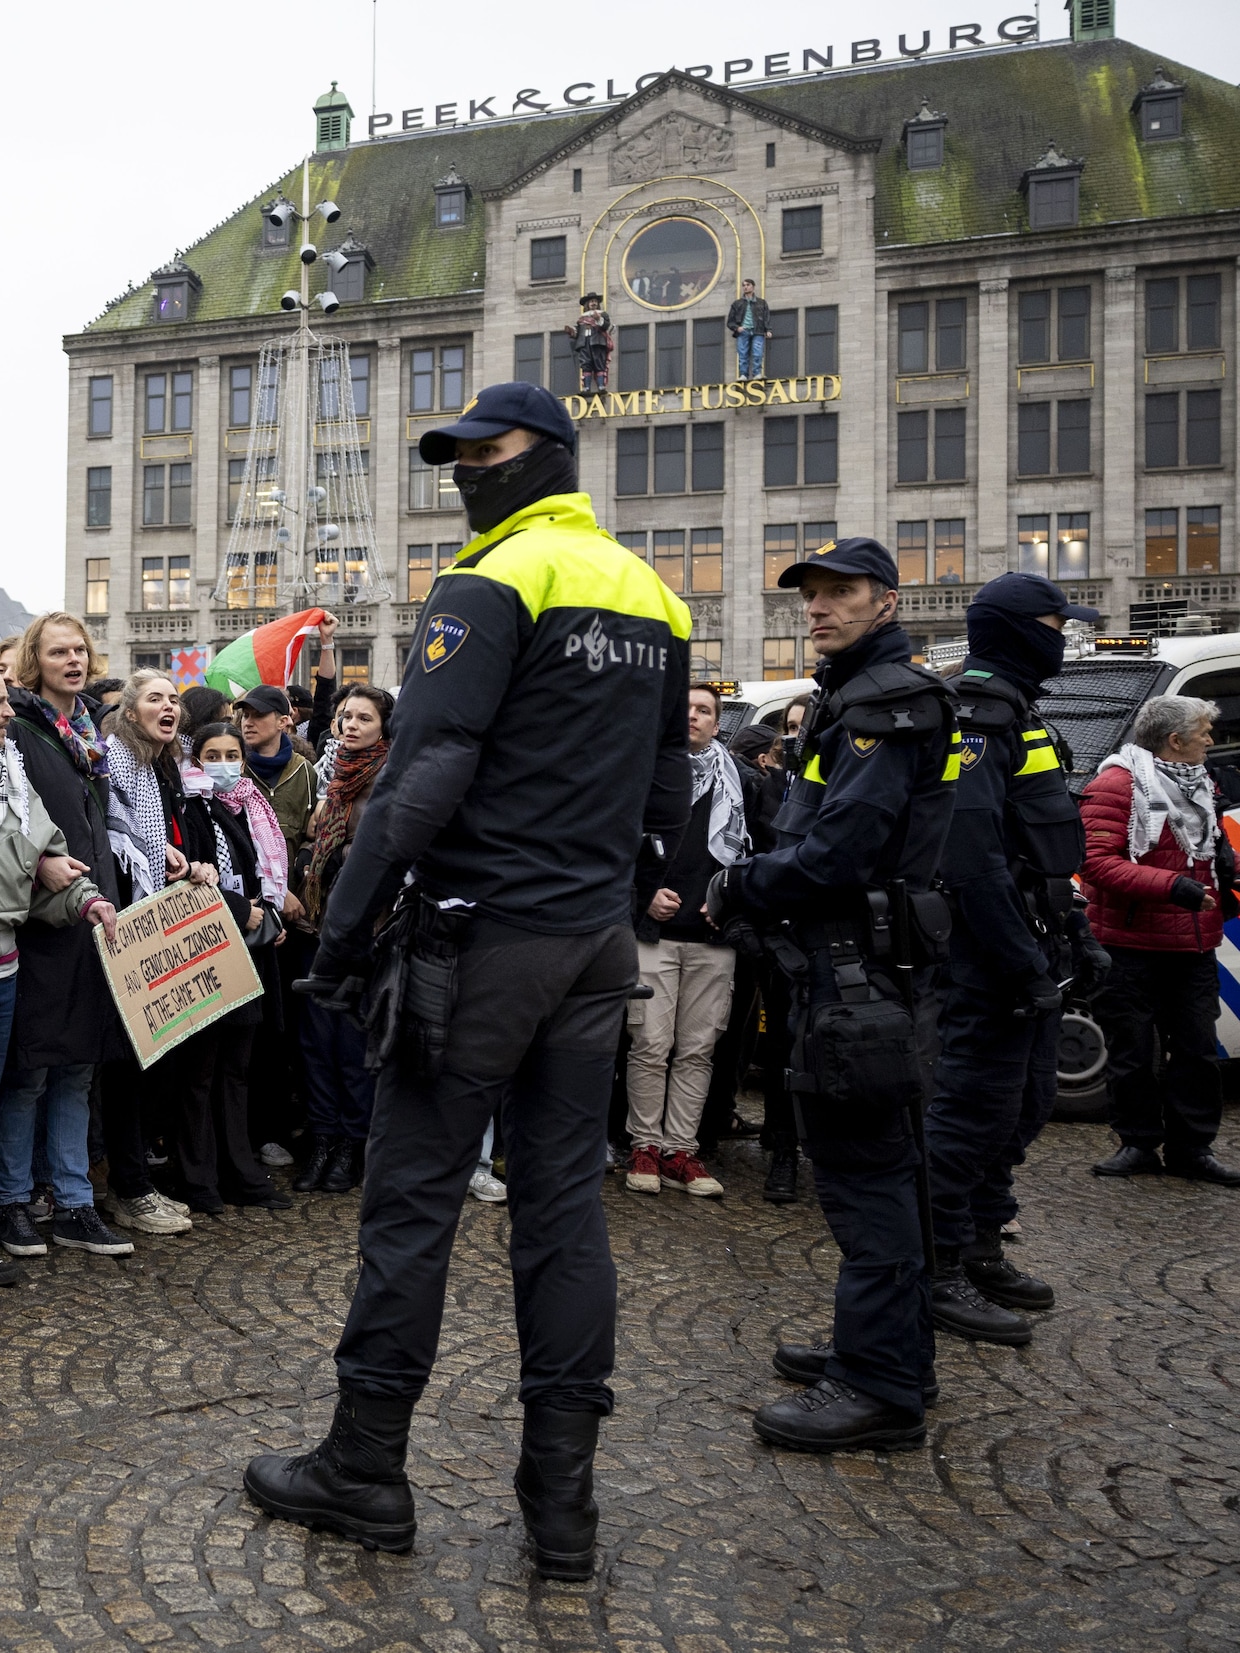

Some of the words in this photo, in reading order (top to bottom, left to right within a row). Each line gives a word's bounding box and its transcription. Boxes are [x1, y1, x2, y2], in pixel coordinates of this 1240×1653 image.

[368, 95, 497, 136] PEEK
[559, 388, 666, 420] DAME
[675, 375, 842, 413] TUSSAUD
[430, 621, 465, 636] POLITIE
[564, 630, 668, 673] POLITIE
[118, 922, 137, 948] CAN
[133, 909, 159, 942] FIGHT
[124, 970, 141, 997] AND
[140, 943, 188, 983] GENOCIDAL
[183, 921, 228, 959] ZIONISM
[142, 1003, 159, 1035] AT
[152, 993, 175, 1025] THE
[170, 980, 197, 1012] SAME
[192, 966, 222, 998] TIME
